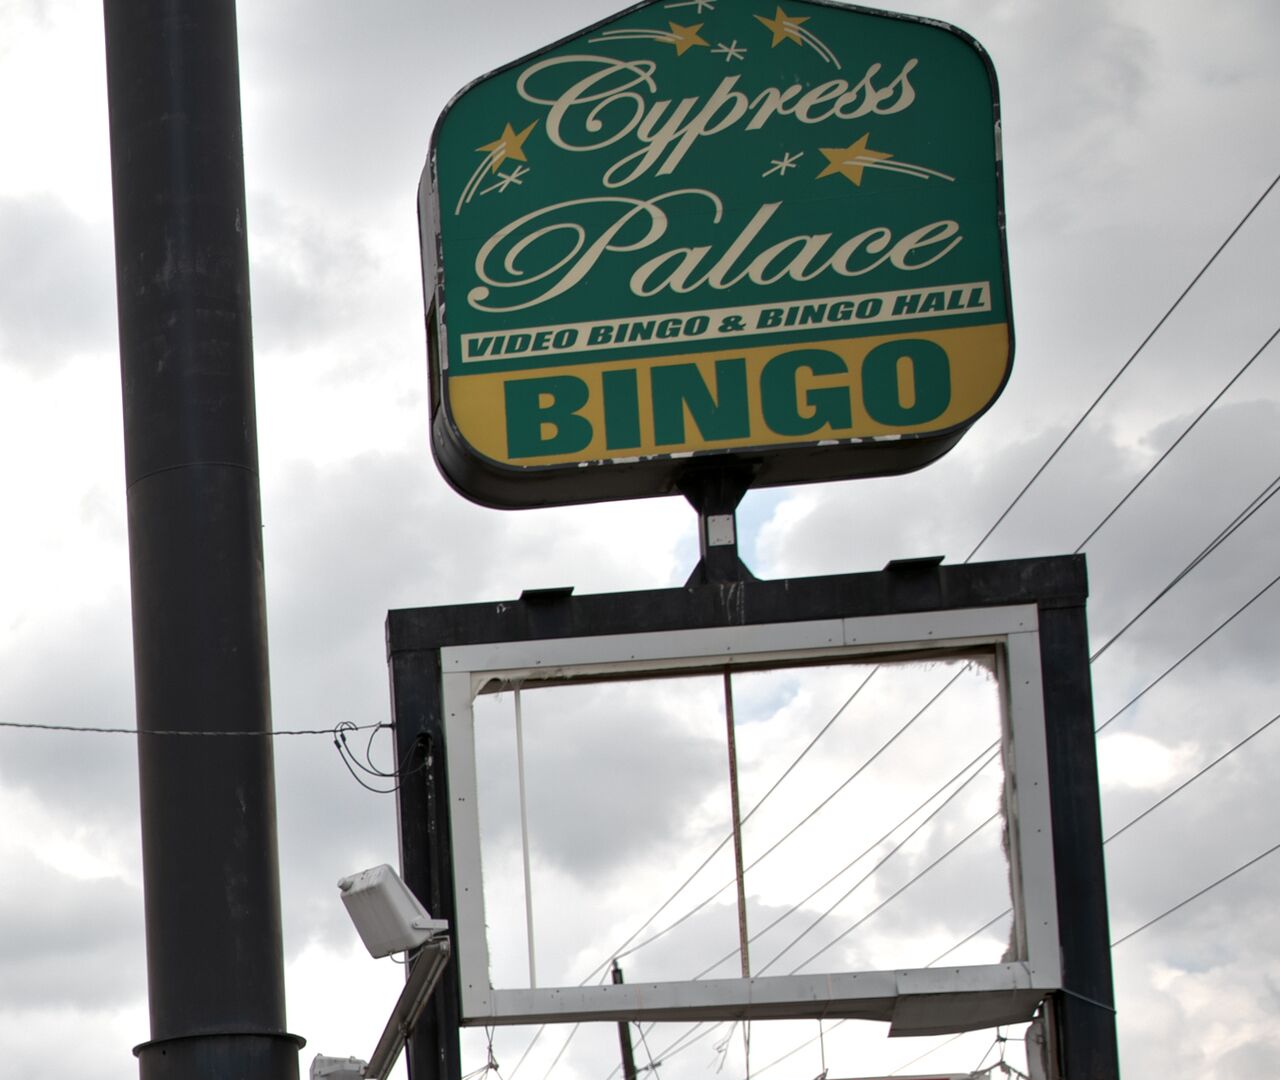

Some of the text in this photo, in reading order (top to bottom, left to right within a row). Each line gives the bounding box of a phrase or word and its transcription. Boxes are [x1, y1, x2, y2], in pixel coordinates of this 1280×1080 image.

[517, 54, 919, 188] Cypress
[467, 188, 964, 313] Palace
[467, 285, 986, 359] VIDEO BINGO & BINGO HALL
[503, 338, 952, 460] BINGO
